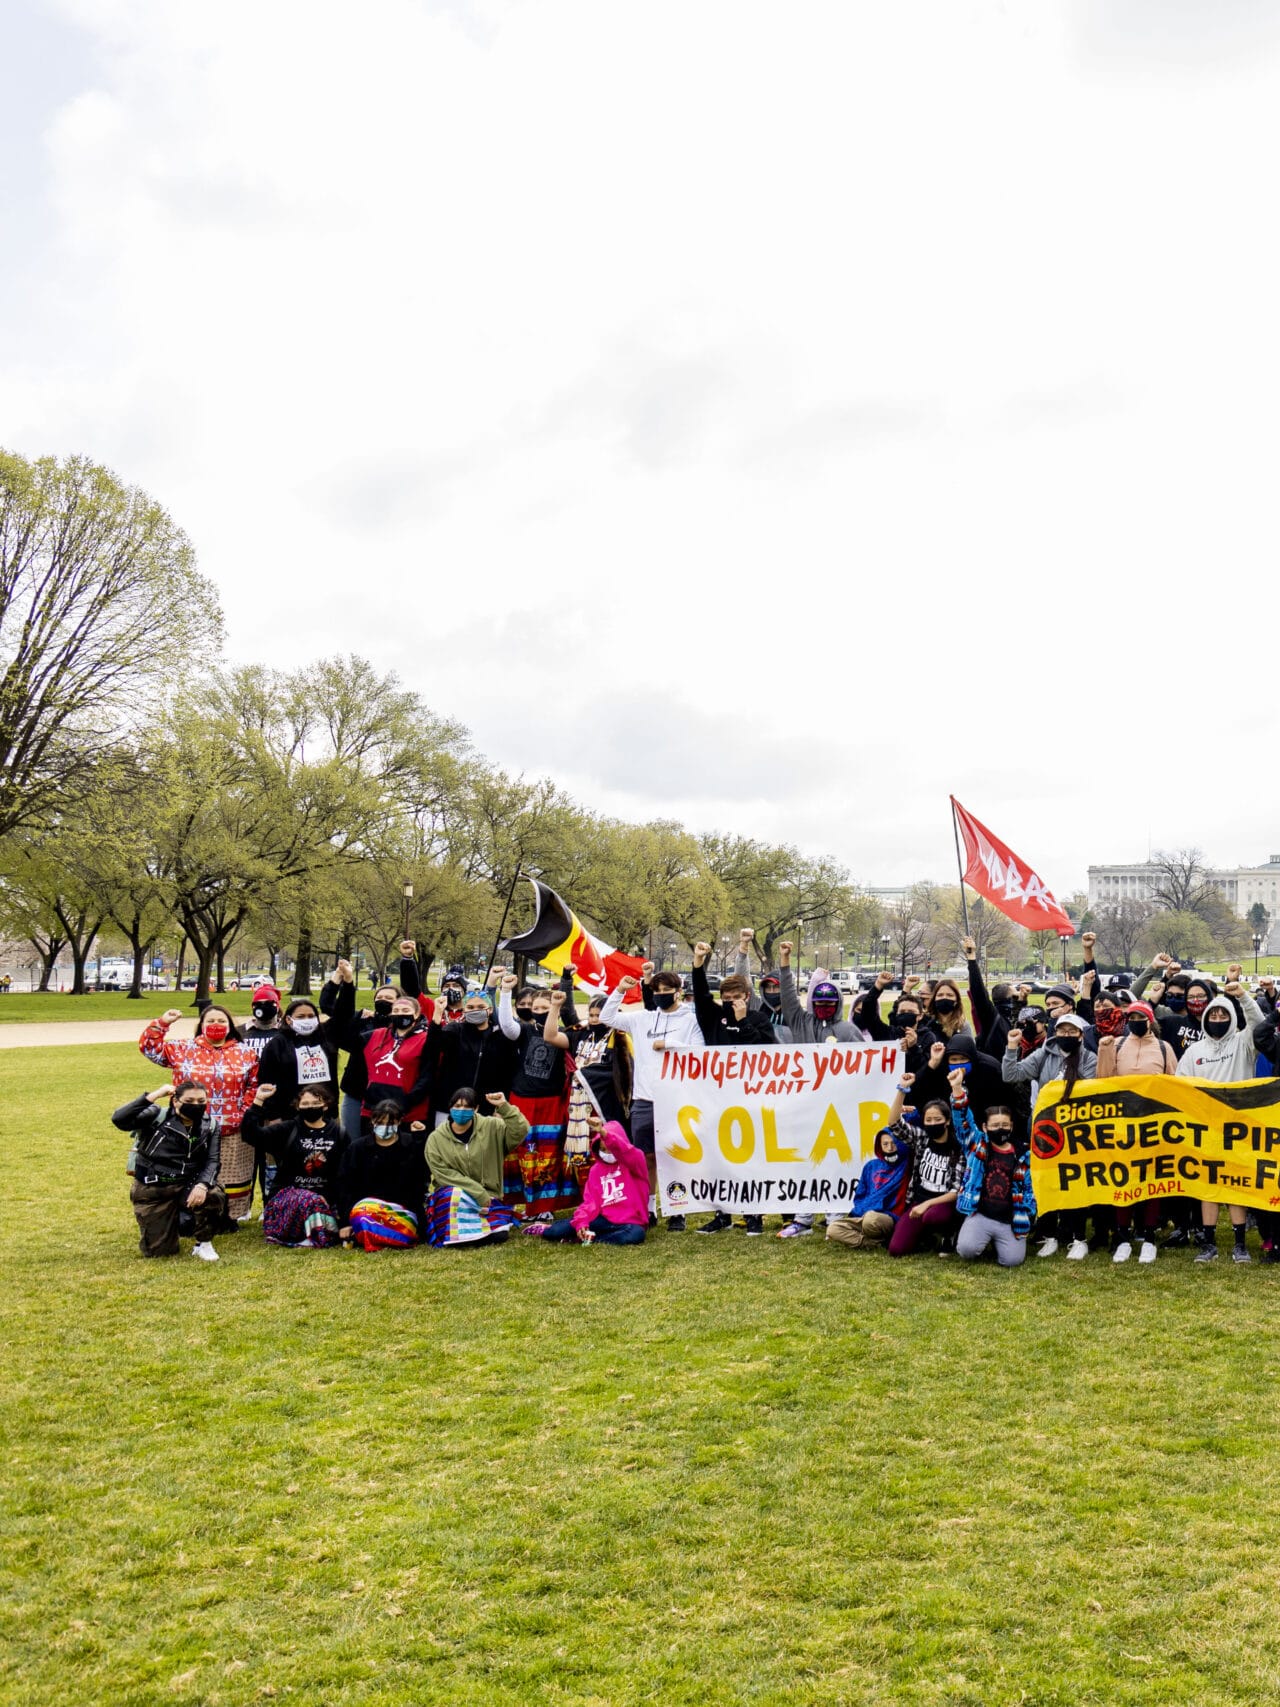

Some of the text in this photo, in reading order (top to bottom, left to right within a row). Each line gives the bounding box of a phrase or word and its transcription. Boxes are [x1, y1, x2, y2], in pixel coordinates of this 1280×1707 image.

[1177, 1026, 1203, 1041] BKLY
[302, 1071, 327, 1080] WATER
[660, 1049, 804, 1088] INDIGENOUS
[744, 1079, 810, 1095] WANT
[1055, 1102, 1123, 1124] Biden:
[1066, 1120, 1208, 1155] REJECT
[1058, 1155, 1225, 1191] PROTECT
[1220, 1174, 1251, 1187] THE
[1148, 1180, 1185, 1196] DAPL
